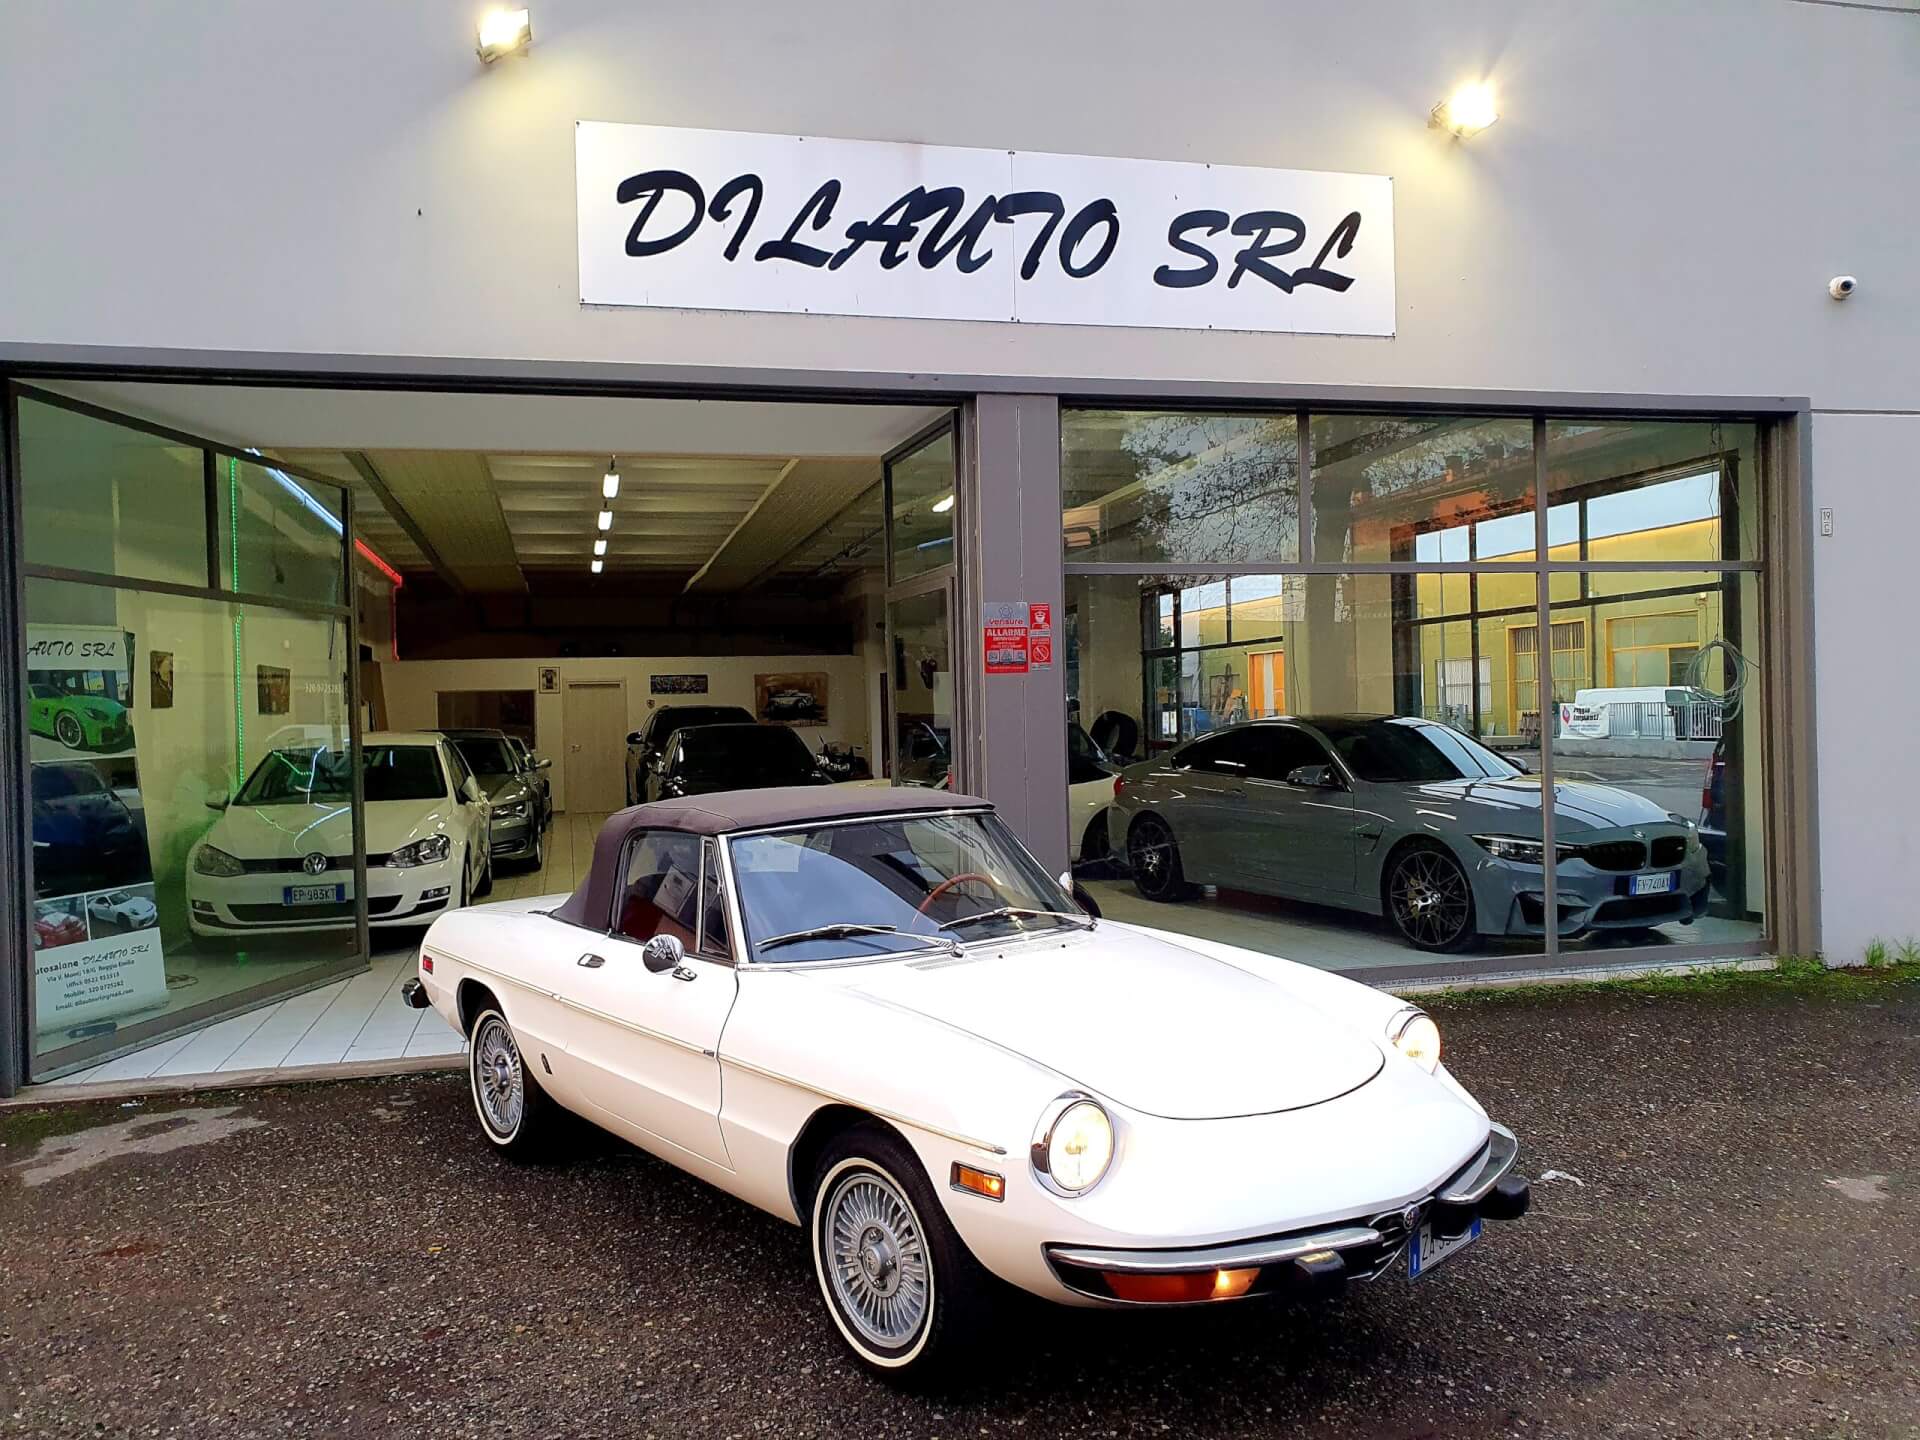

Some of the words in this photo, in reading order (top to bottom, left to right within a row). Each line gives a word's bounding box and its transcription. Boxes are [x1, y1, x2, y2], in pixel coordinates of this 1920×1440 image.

[616, 170, 1120, 281] DILAUTO
[1153, 209, 1362, 295] SRL
[986, 628, 1026, 636] ALLARME
[27, 640, 74, 656] AUTO
[80, 641, 116, 658] SRL
[34, 961, 79, 976] utosalone
